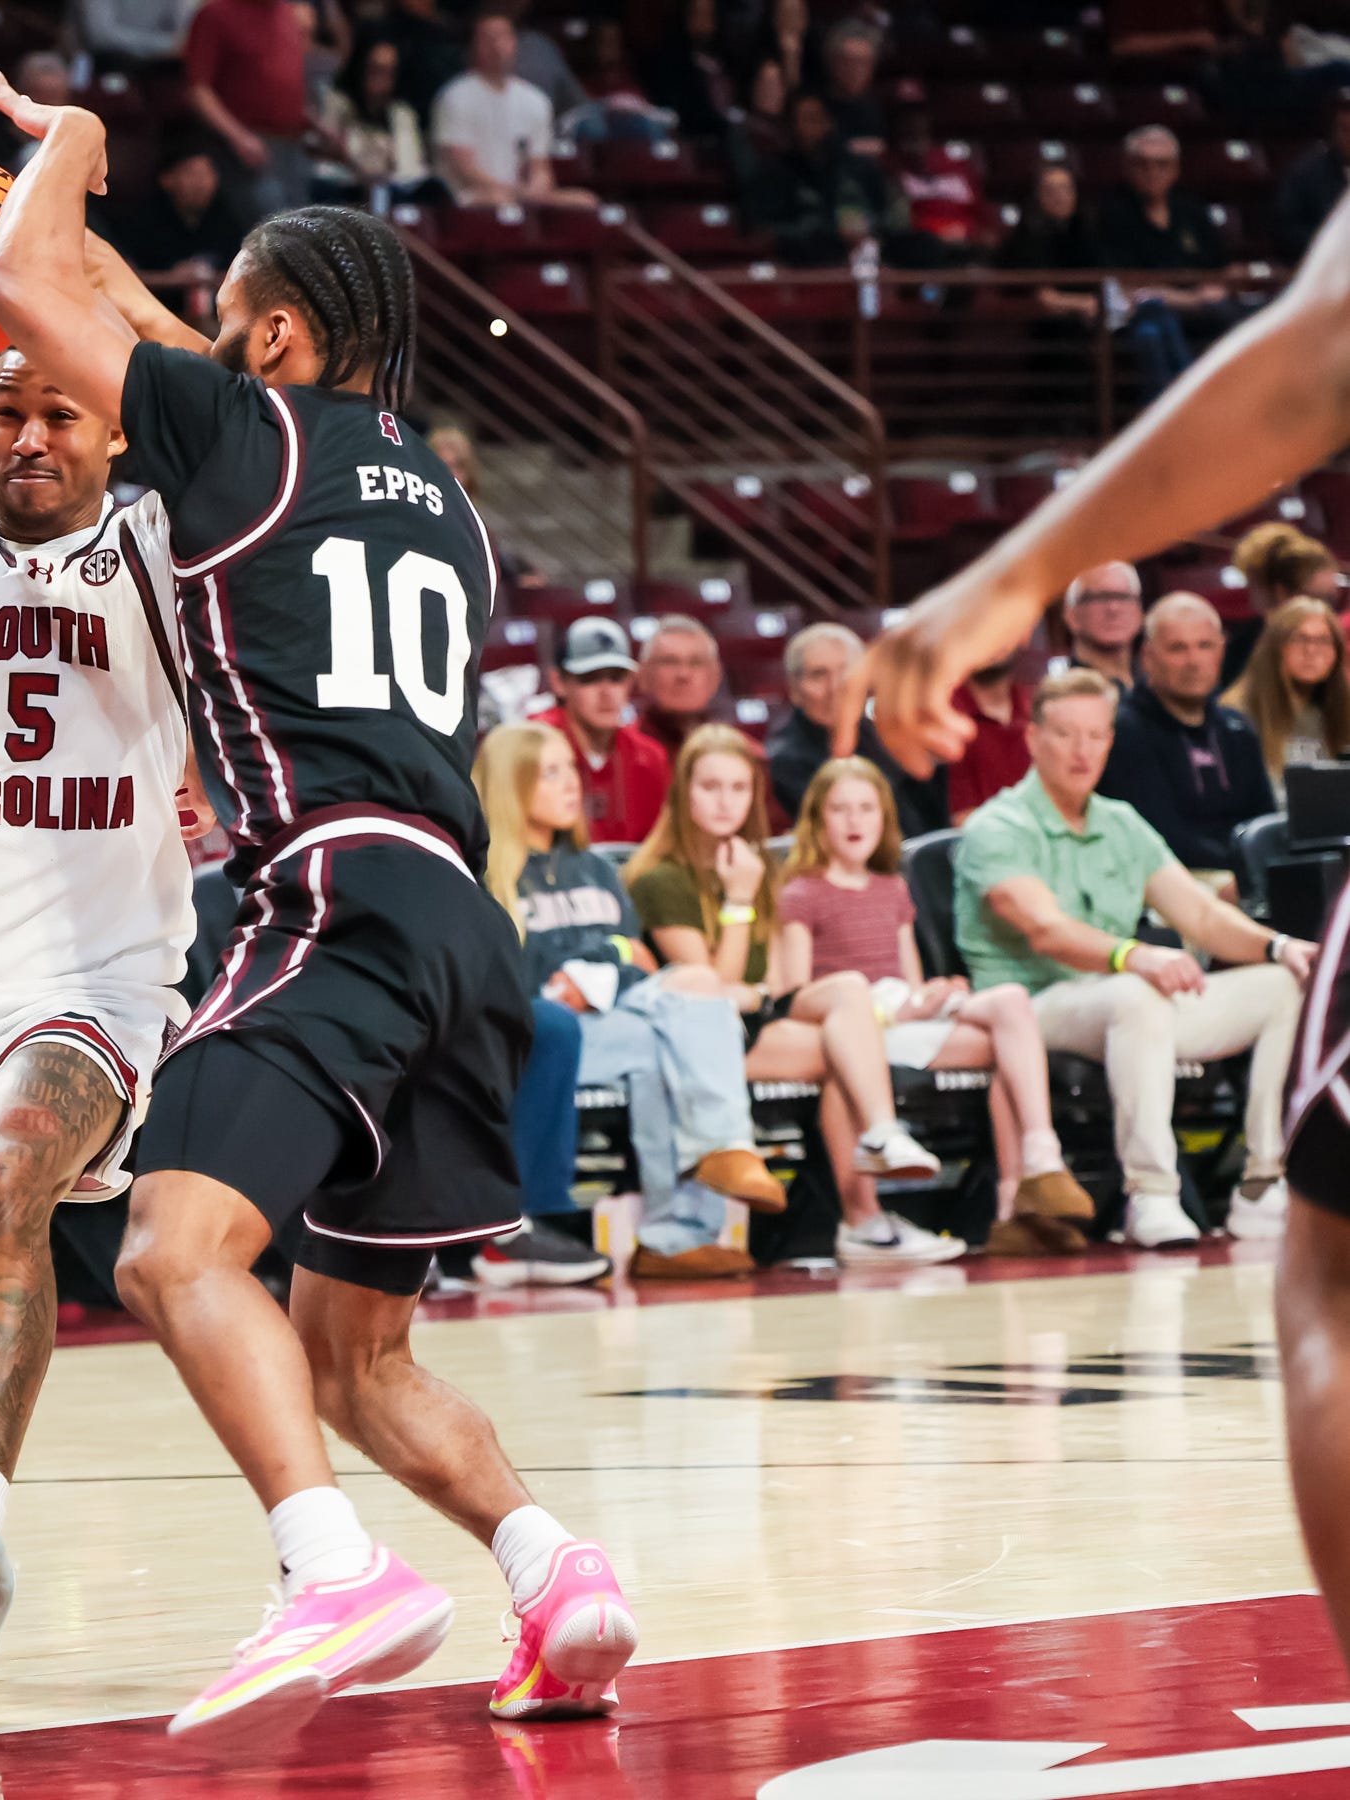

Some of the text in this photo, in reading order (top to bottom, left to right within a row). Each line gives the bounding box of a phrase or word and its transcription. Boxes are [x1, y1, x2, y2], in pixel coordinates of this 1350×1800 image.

[356, 465, 444, 516] EPPS
[83, 550, 118, 584] SEC
[311, 536, 472, 737] 10
[4, 672, 61, 763] 5
